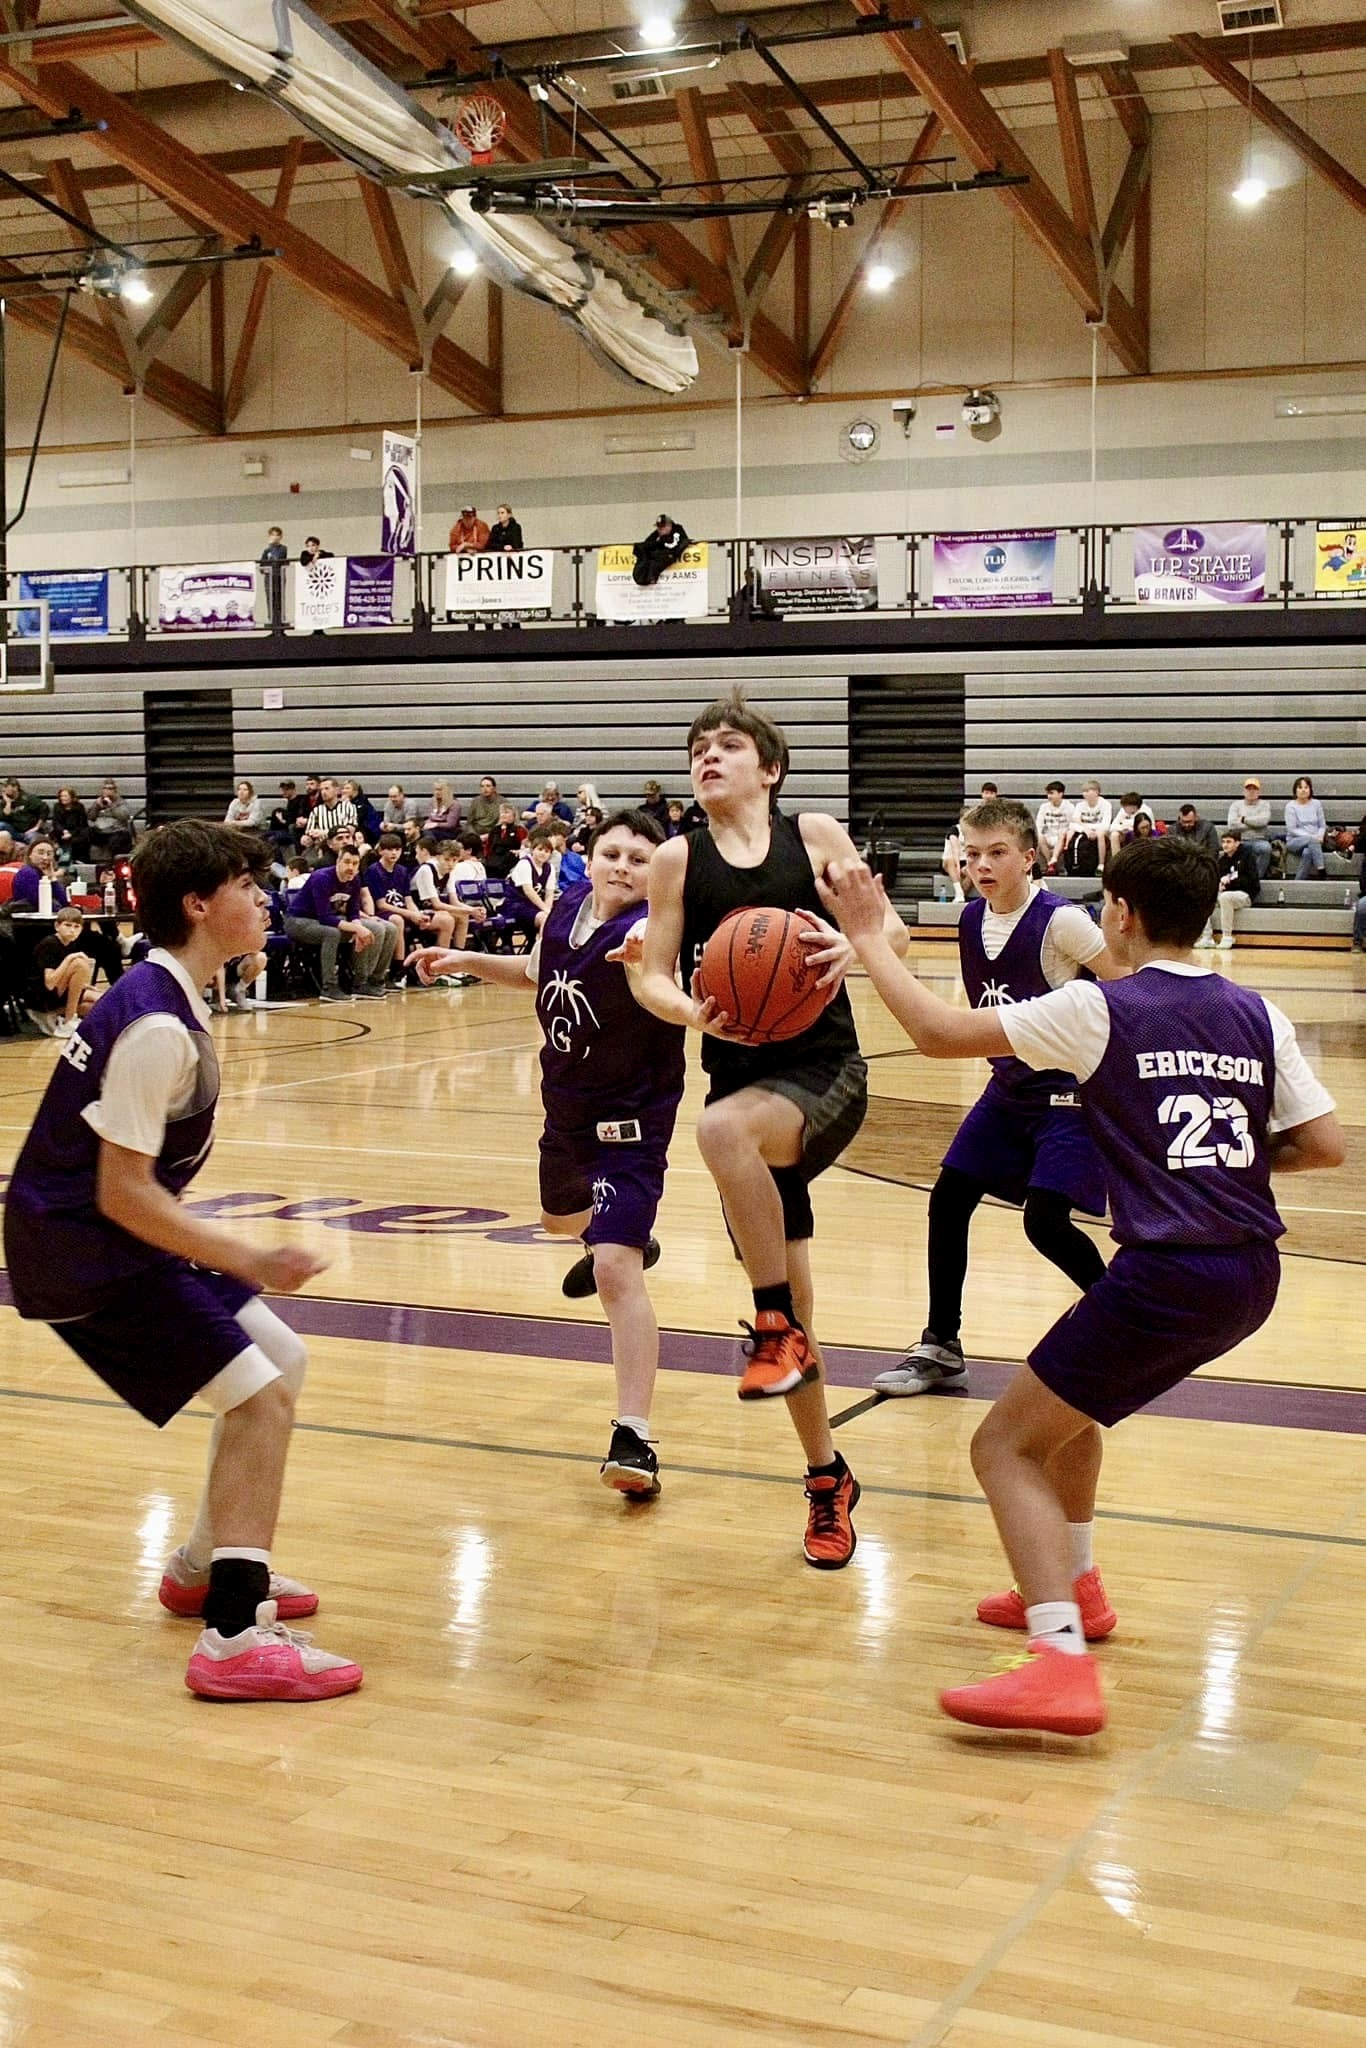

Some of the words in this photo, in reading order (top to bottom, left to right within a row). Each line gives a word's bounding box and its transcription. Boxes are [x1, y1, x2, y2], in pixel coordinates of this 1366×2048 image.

[603, 550, 637, 566] Edwa
[1150, 557, 1183, 577] U.P.
[1188, 554, 1252, 575] STATE
[458, 555, 543, 581] PRINS
[672, 571, 697, 579] AAMS
[769, 569, 871, 582] FITNESS
[1189, 574, 1221, 584] CREDIT
[1224, 573, 1252, 582] UNION
[1138, 588, 1150, 600] GO
[1154, 587, 1197, 600] BRAVES!
[1136, 1050, 1265, 1087] ERICKSON
[1157, 1094, 1256, 1171] 23
